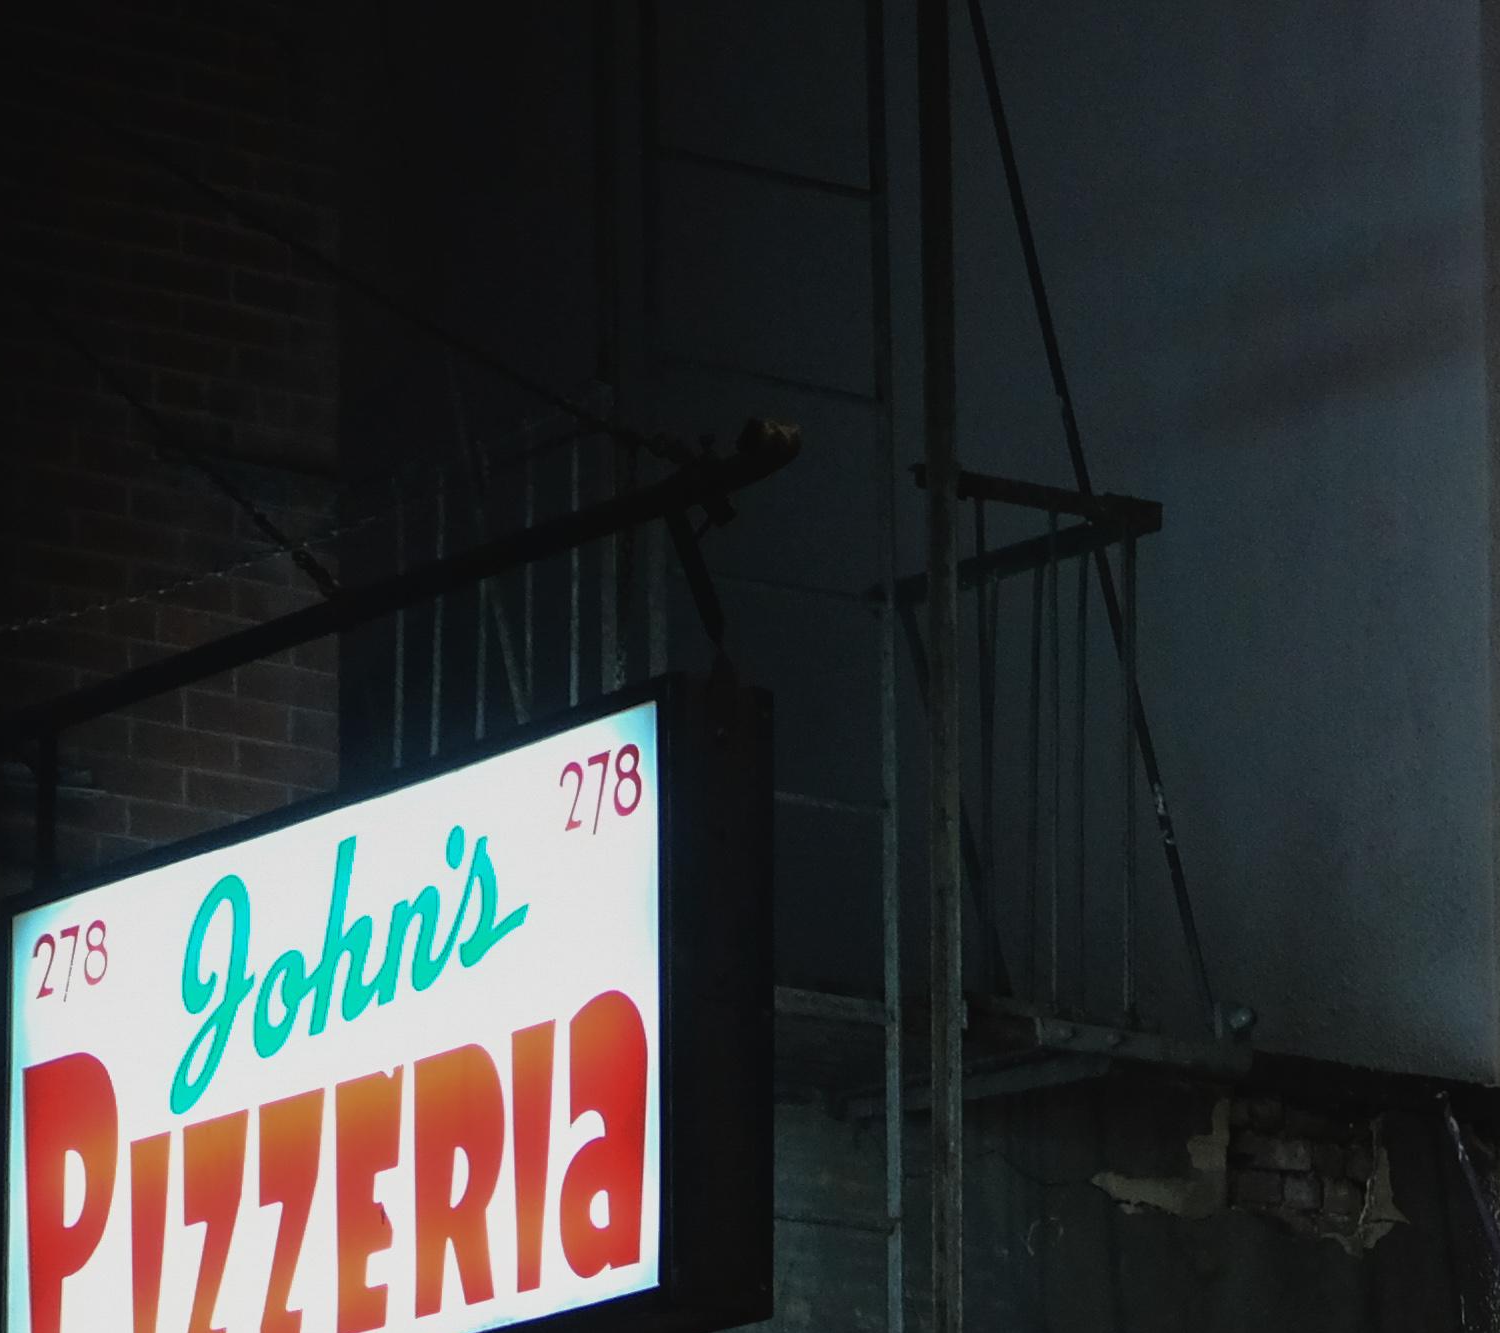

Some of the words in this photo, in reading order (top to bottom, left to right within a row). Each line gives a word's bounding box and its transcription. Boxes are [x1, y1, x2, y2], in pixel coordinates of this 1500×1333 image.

[558, 743, 643, 836] 278
[31, 918, 110, 1003] 278
[169, 824, 529, 1116] John's
